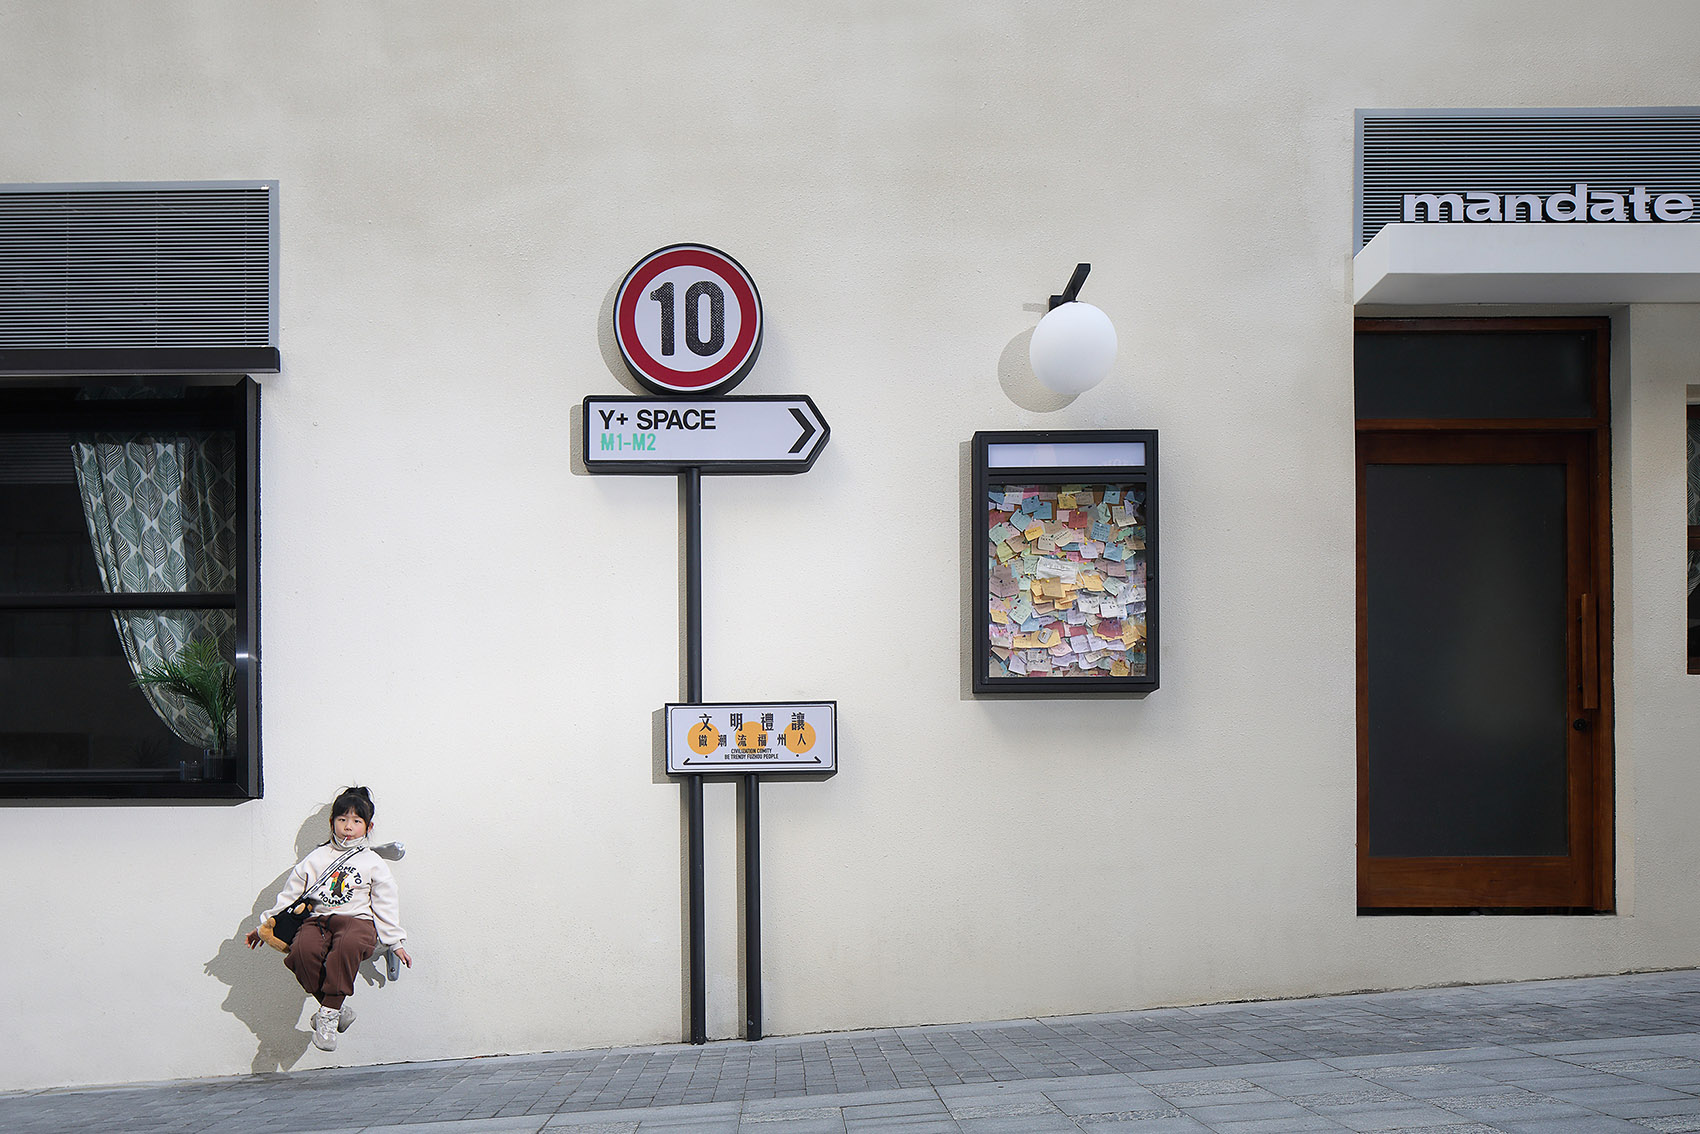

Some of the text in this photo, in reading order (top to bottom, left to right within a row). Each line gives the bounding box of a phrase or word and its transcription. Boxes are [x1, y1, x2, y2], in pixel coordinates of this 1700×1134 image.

[1403, 183, 1694, 222] mandate
[650, 280, 725, 357] 10
[598, 409, 716, 430] Y+ SPACE
[601, 433, 656, 451] M1-M2
[698, 712, 805, 733] 文明禮讓
[337, 865, 362, 884] OME TO
